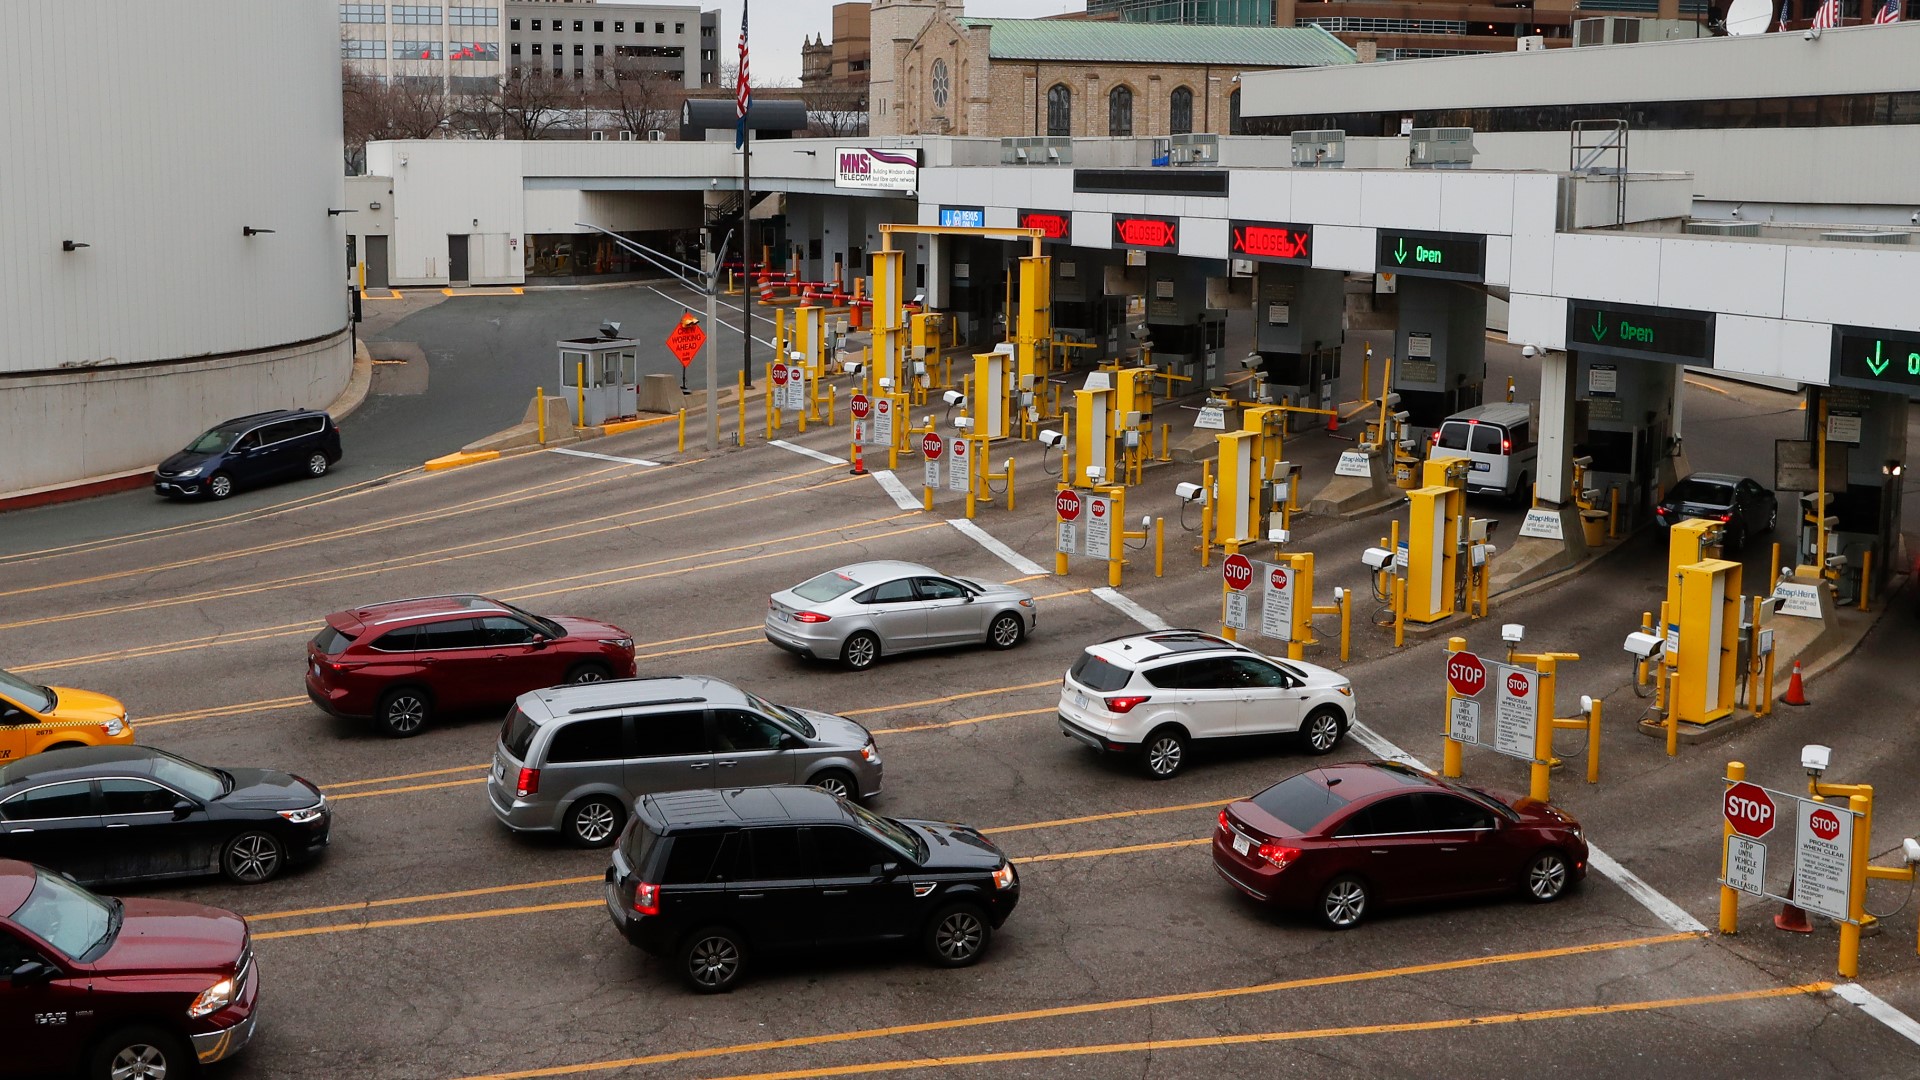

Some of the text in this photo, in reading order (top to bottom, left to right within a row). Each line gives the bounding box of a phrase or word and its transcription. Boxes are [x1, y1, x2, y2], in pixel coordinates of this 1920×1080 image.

[840, 154, 871, 173] MNSi
[961, 211, 978, 221] NEXUS
[1128, 224, 1162, 242] CLOSED
[1249, 234, 1290, 252] CLOSED
[1416, 246, 1442, 264] Open
[1620, 321, 1653, 342] Open
[672, 334, 701, 344] WORKING
[676, 343, 696, 351] AHEAD
[773, 370, 787, 379] STOP
[852, 401, 868, 411] STOP
[924, 440, 940, 451] STOP
[1058, 498, 1078, 512] STOP
[1528, 514, 1543, 522] Stop
[1226, 564, 1250, 580] STOP
[1272, 574, 1286, 584] STOP
[1776, 587, 1816, 599] Stop Here
[1450, 663, 1482, 684] STOP
[1508, 679, 1528, 691] STOP
[1456, 714, 1473, 722] VEHICLE
[1453, 732, 1475, 742] RELEASED
[1728, 796, 1771, 823] STOP
[1812, 816, 1838, 833] STOP
[1740, 841, 1753, 850] STOP
[1809, 839, 1838, 851] PROCEED
[1738, 849, 1753, 859] UNTIL
[1803, 844, 1844, 858] WHEN CLEAR
[1734, 856, 1757, 868] VEHICLE
[1817, 861, 1843, 872] DOCUMENTS
[1736, 864, 1754, 875] AHEAD
[1802, 868, 1825, 878] PASSPORT
[1730, 878, 1758, 892] RELEASED
[1802, 879, 1825, 889] ENHANCED
[1801, 890, 1824, 899] PASSPORT
